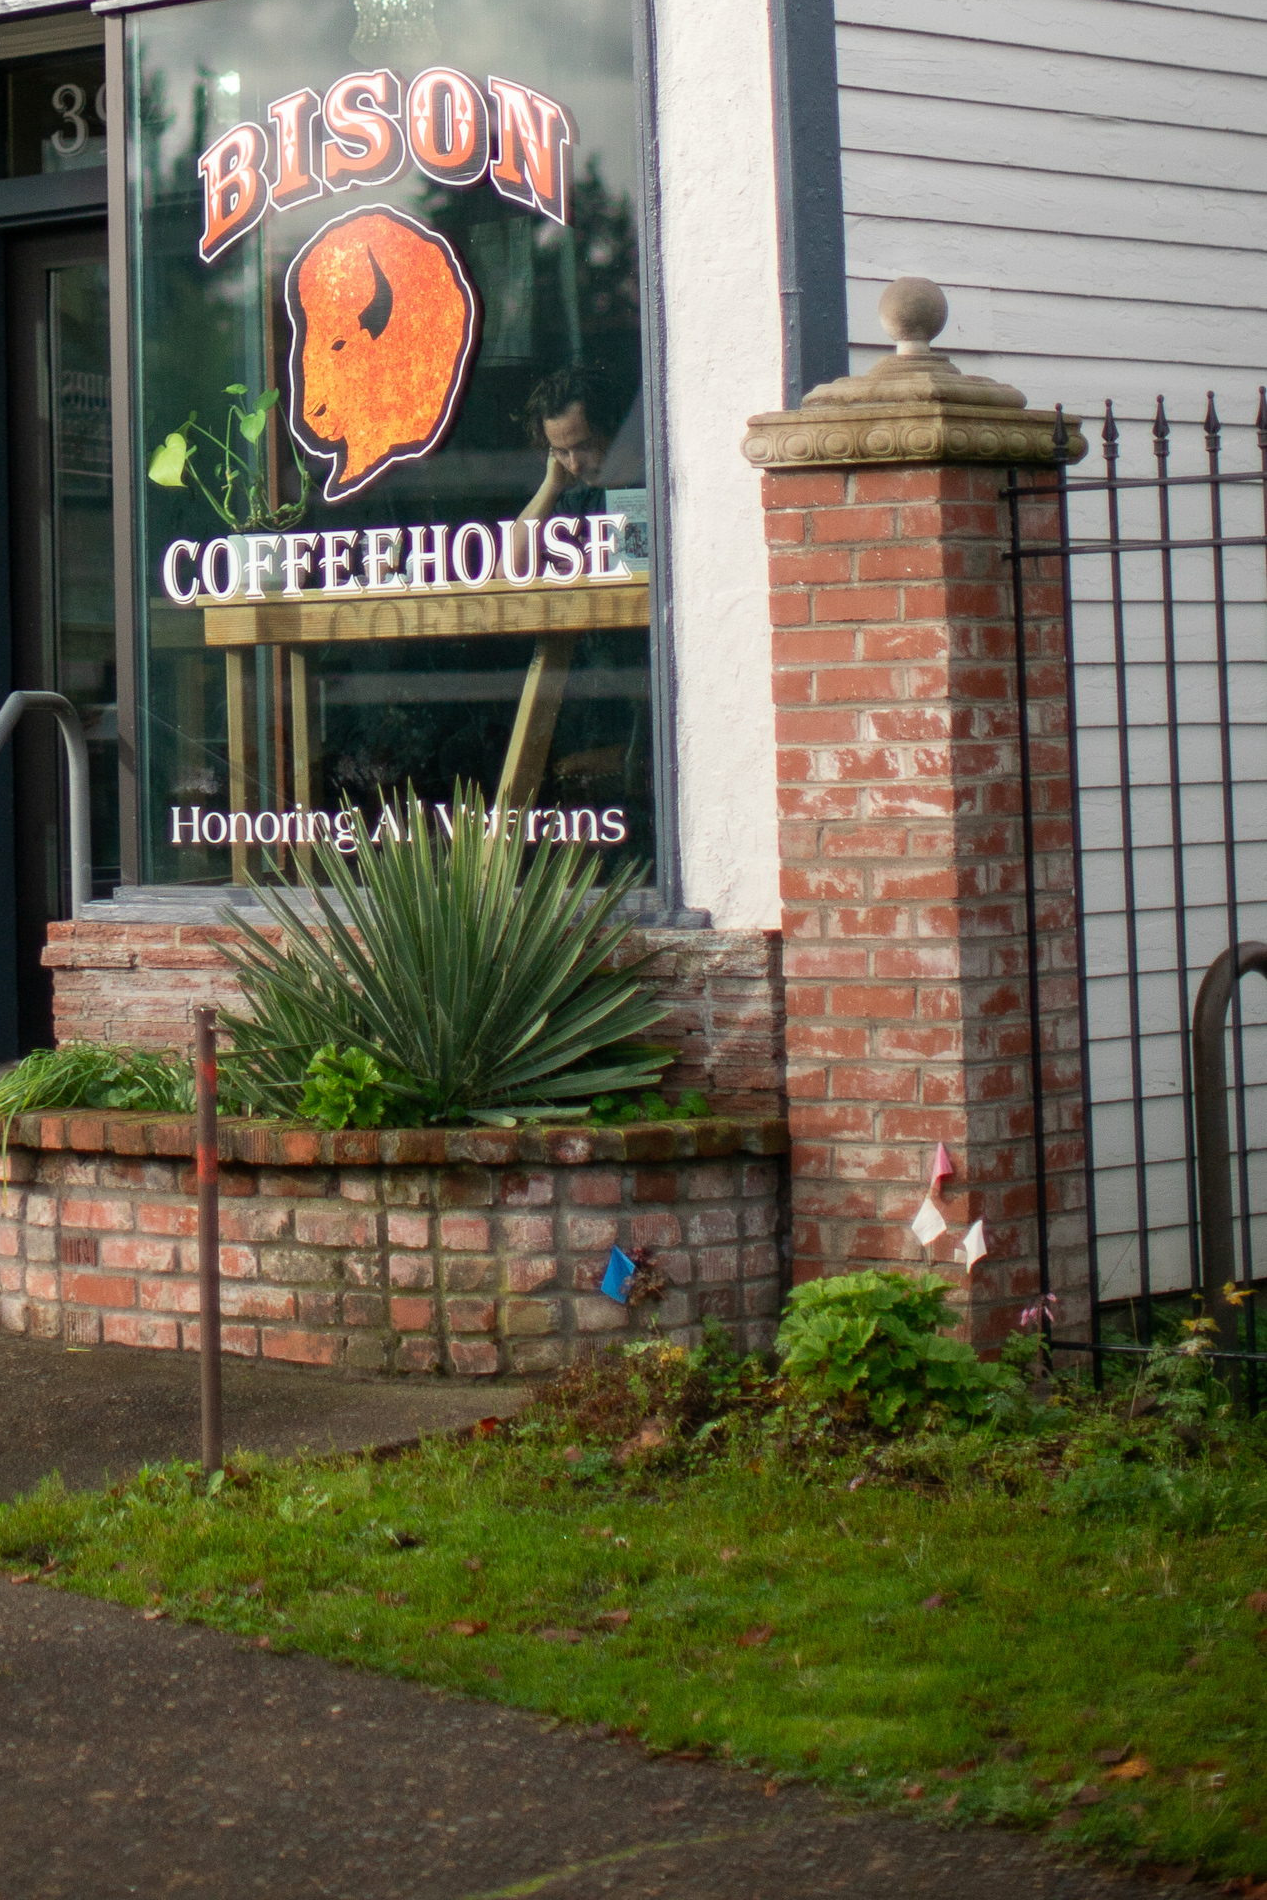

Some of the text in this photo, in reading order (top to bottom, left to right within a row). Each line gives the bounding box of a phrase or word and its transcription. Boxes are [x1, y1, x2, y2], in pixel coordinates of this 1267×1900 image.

[198, 66, 573, 263] BISON
[162, 513, 633, 604] COFFEEHOUSE
[170, 803, 360, 853] Honoring
